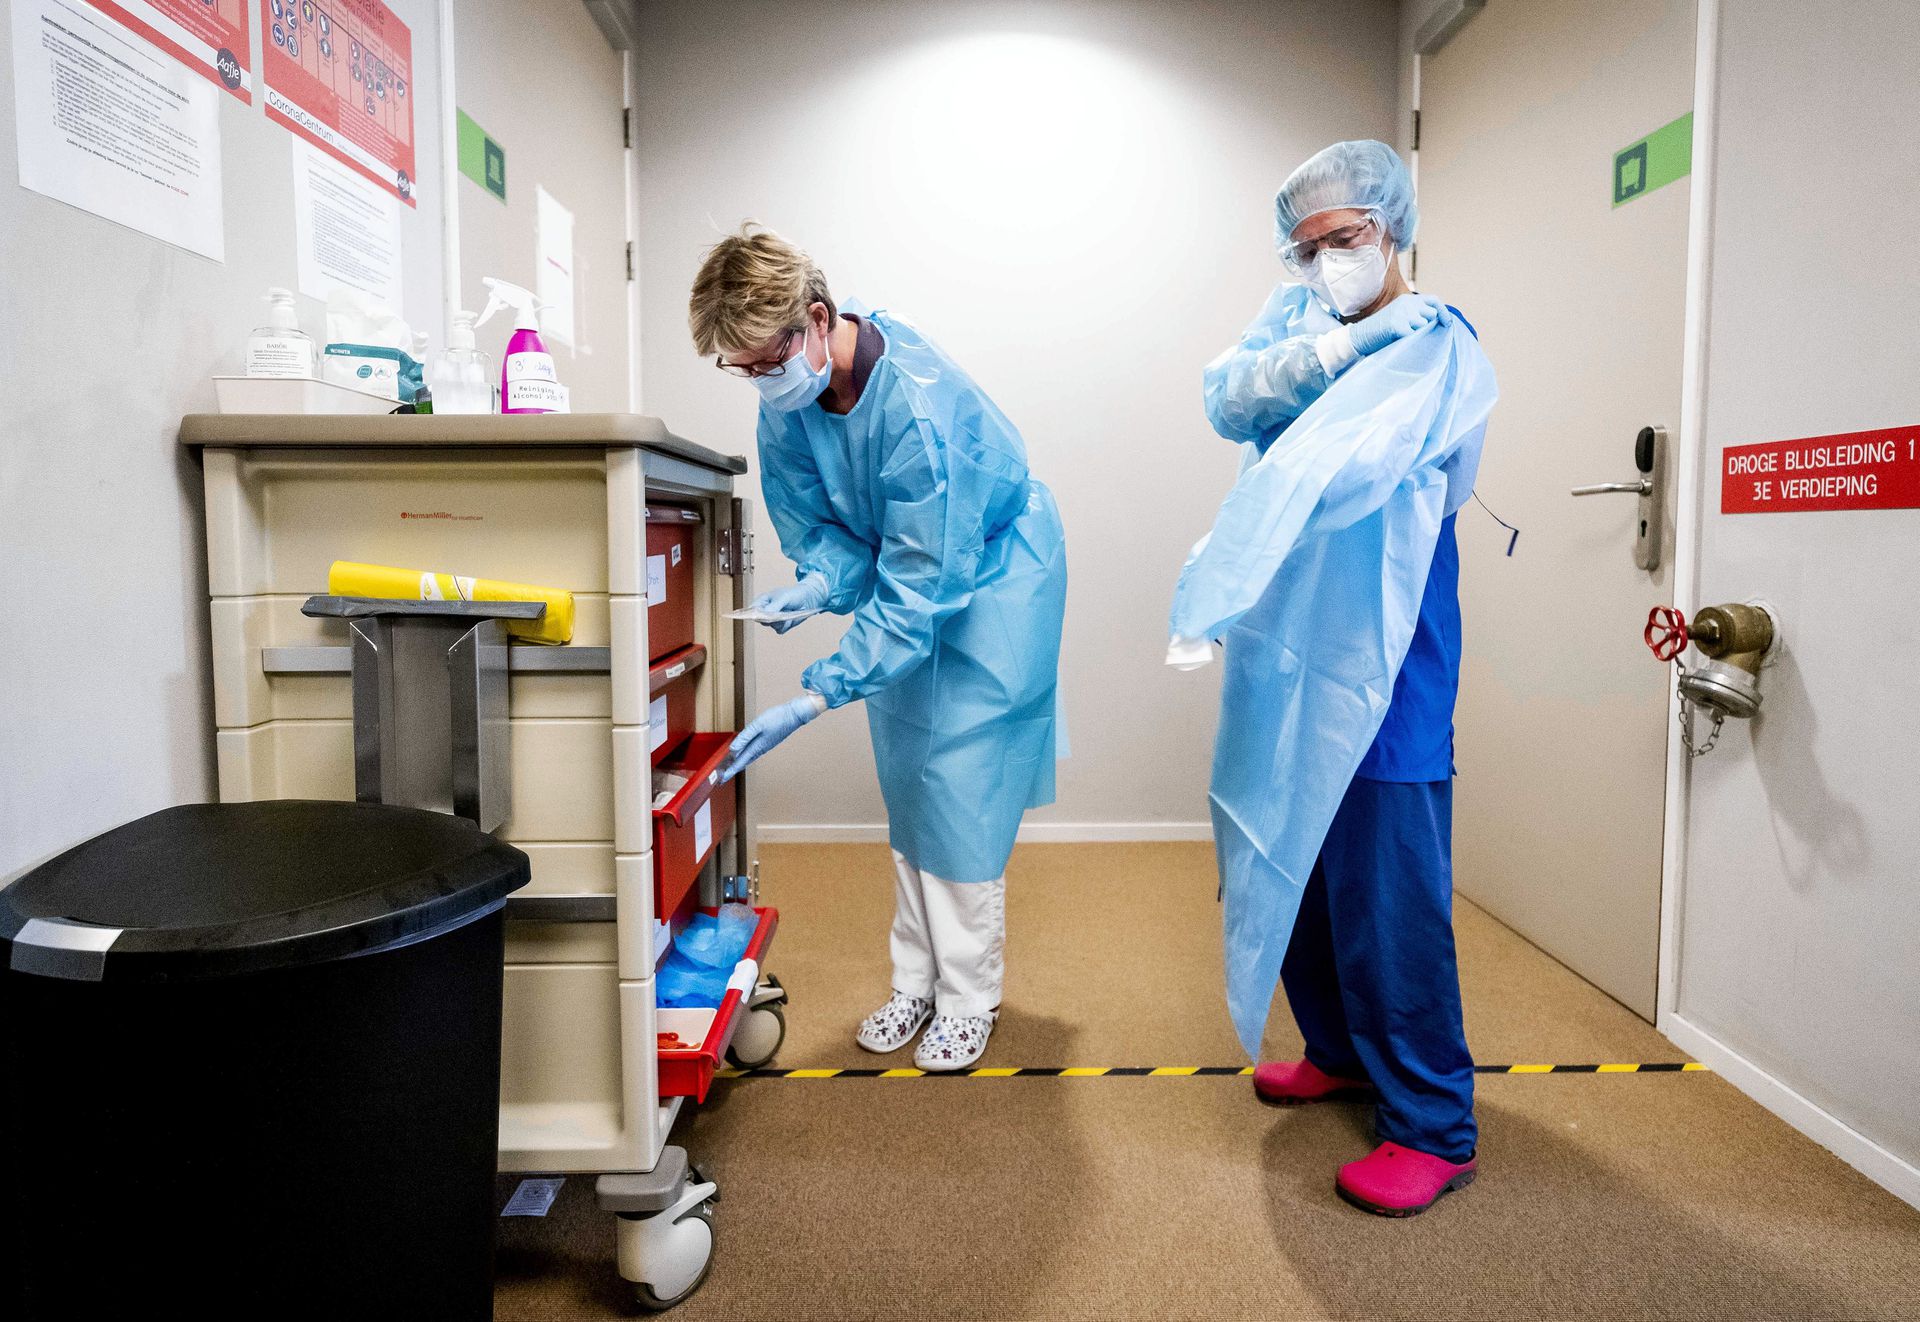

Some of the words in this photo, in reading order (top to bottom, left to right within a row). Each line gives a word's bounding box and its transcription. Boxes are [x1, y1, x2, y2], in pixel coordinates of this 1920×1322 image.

[217, 58, 240, 79] Aafje
[269, 91, 334, 143] CoronaCentrum
[1728, 452, 1778, 475] DROGE
[1785, 440, 1895, 471] BLUSLEIDING
[1908, 438, 1915, 460] 1
[1753, 481, 1772, 501] 3E
[1780, 474, 1877, 500] VERDIEPING
